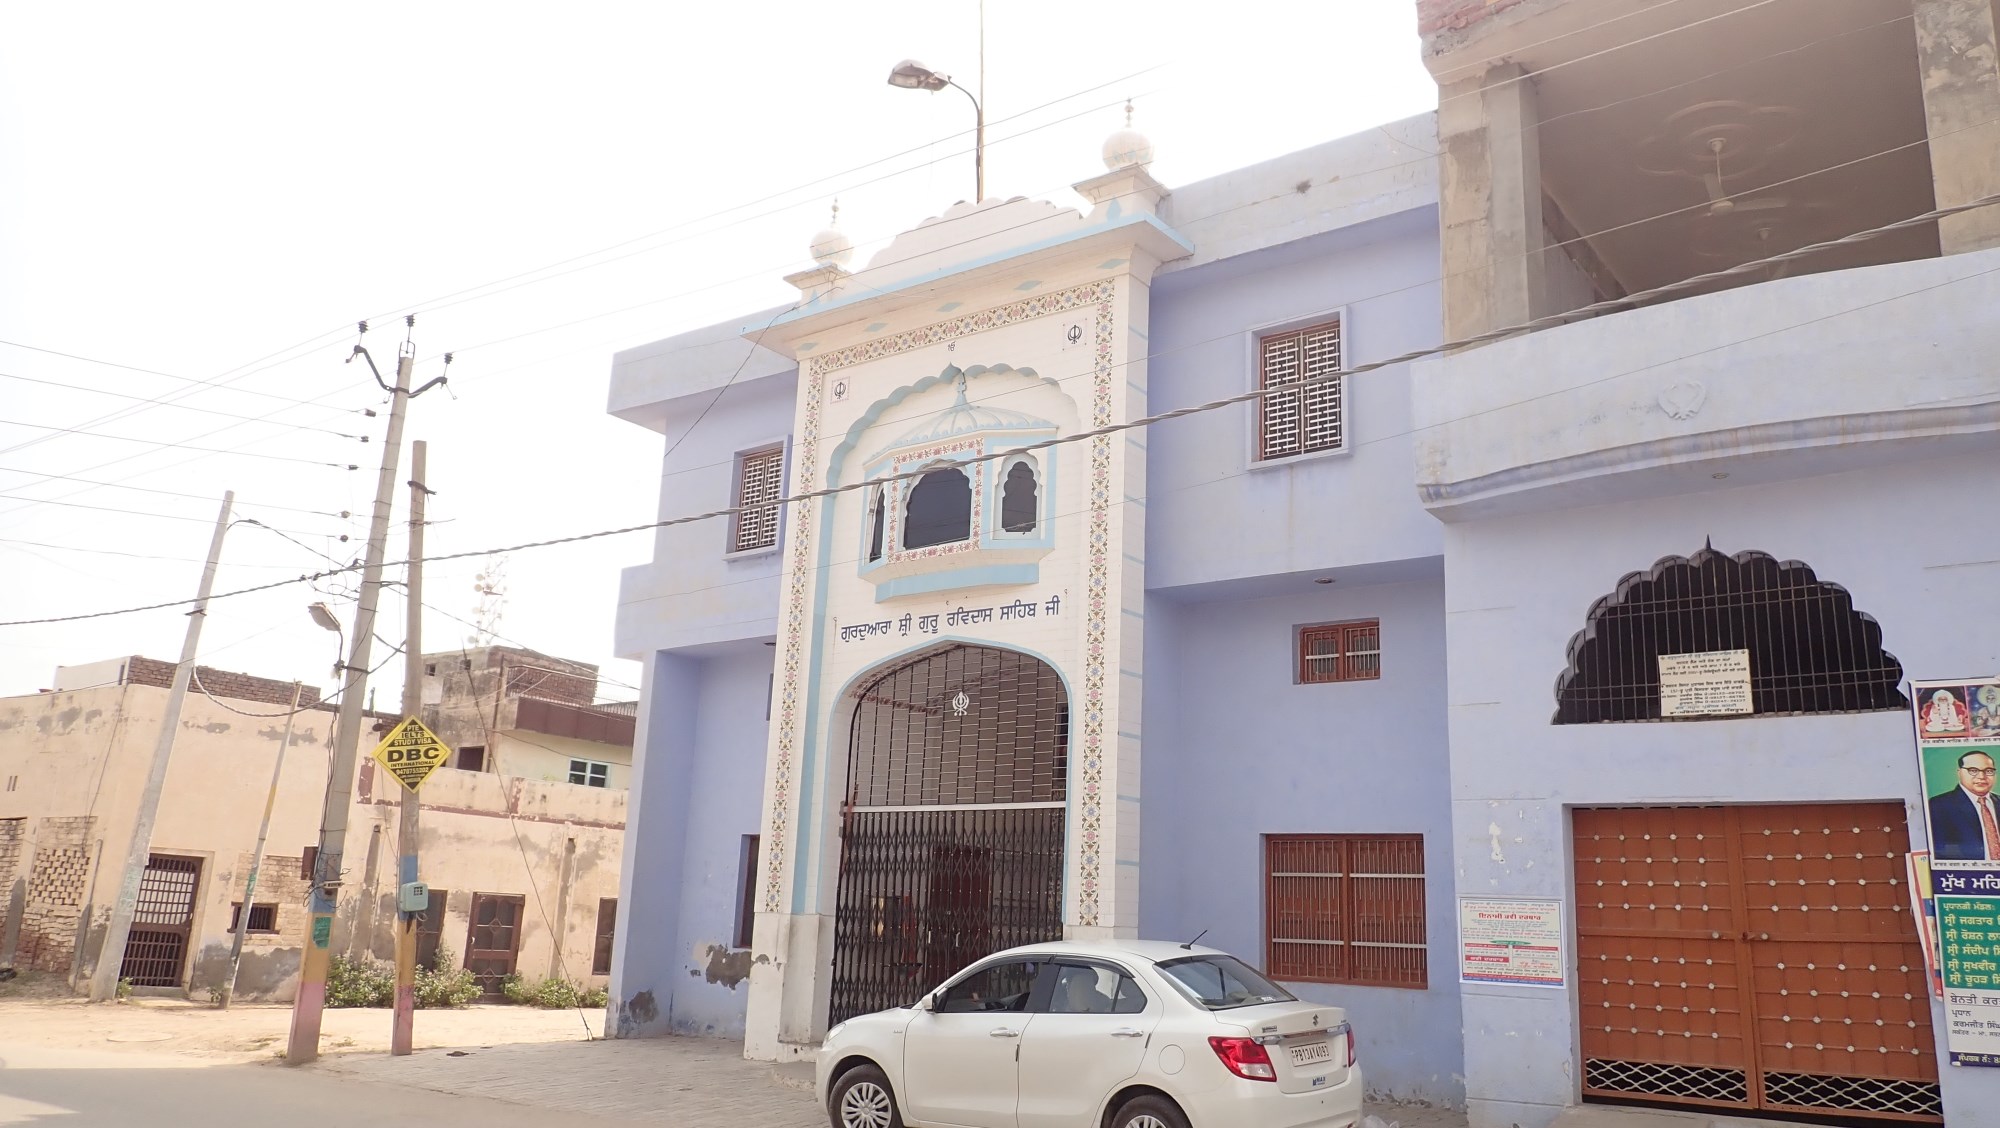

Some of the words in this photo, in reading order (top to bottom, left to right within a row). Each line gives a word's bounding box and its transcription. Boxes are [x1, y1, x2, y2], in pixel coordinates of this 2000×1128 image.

[841, 621, 892, 642] ਗੁਰਦੁਆਰਾ
[919, 615, 939, 634] ਗੁਰੂ
[947, 606, 993, 626] ਰਵਿਦਾਸ
[1000, 599, 1037, 620] ਸਾਹਿਬ
[1045, 595, 1060, 615] ਜੀ
[387, 747, 440, 762] DBC
[390, 760, 435, 768] INTERNATIONAL
[1940, 874, 1966, 891] ਮੁੱਖ
[1959, 916, 1994, 925] ਜਗਤਾਰ
[1962, 944, 1989, 955] ਸੰਦੀਪ
[1950, 993, 1977, 1004] ਬੇਨਤੀ
[1952, 1009, 1971, 1017] ਪ੍ਰਧਾਨ
[1953, 1020, 1984, 1028] ਕਰਮਜੀਤ
